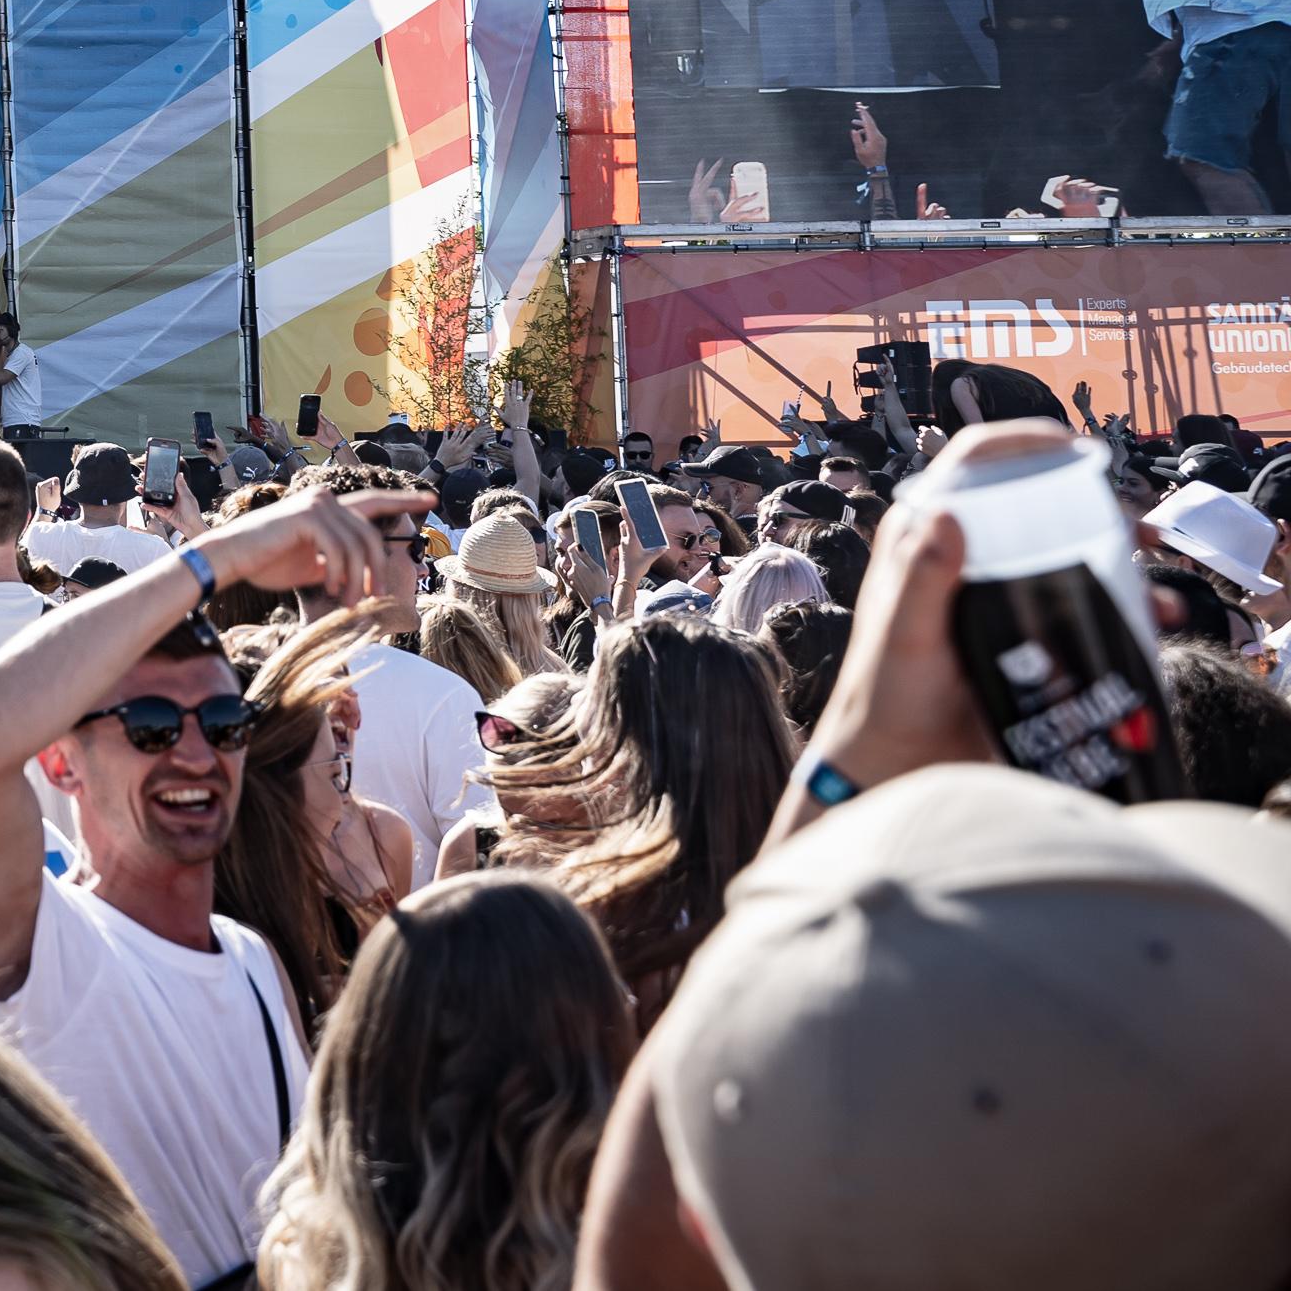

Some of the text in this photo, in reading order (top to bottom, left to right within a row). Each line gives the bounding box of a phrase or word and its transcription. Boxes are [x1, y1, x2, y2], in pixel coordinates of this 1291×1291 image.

[1086, 297, 1127, 311] Experts
[1087, 313, 1137, 327] Managed
[925, 298, 1074, 360] EMS
[1089, 328, 1135, 341] Services
[1208, 329, 1291, 353] UNION
